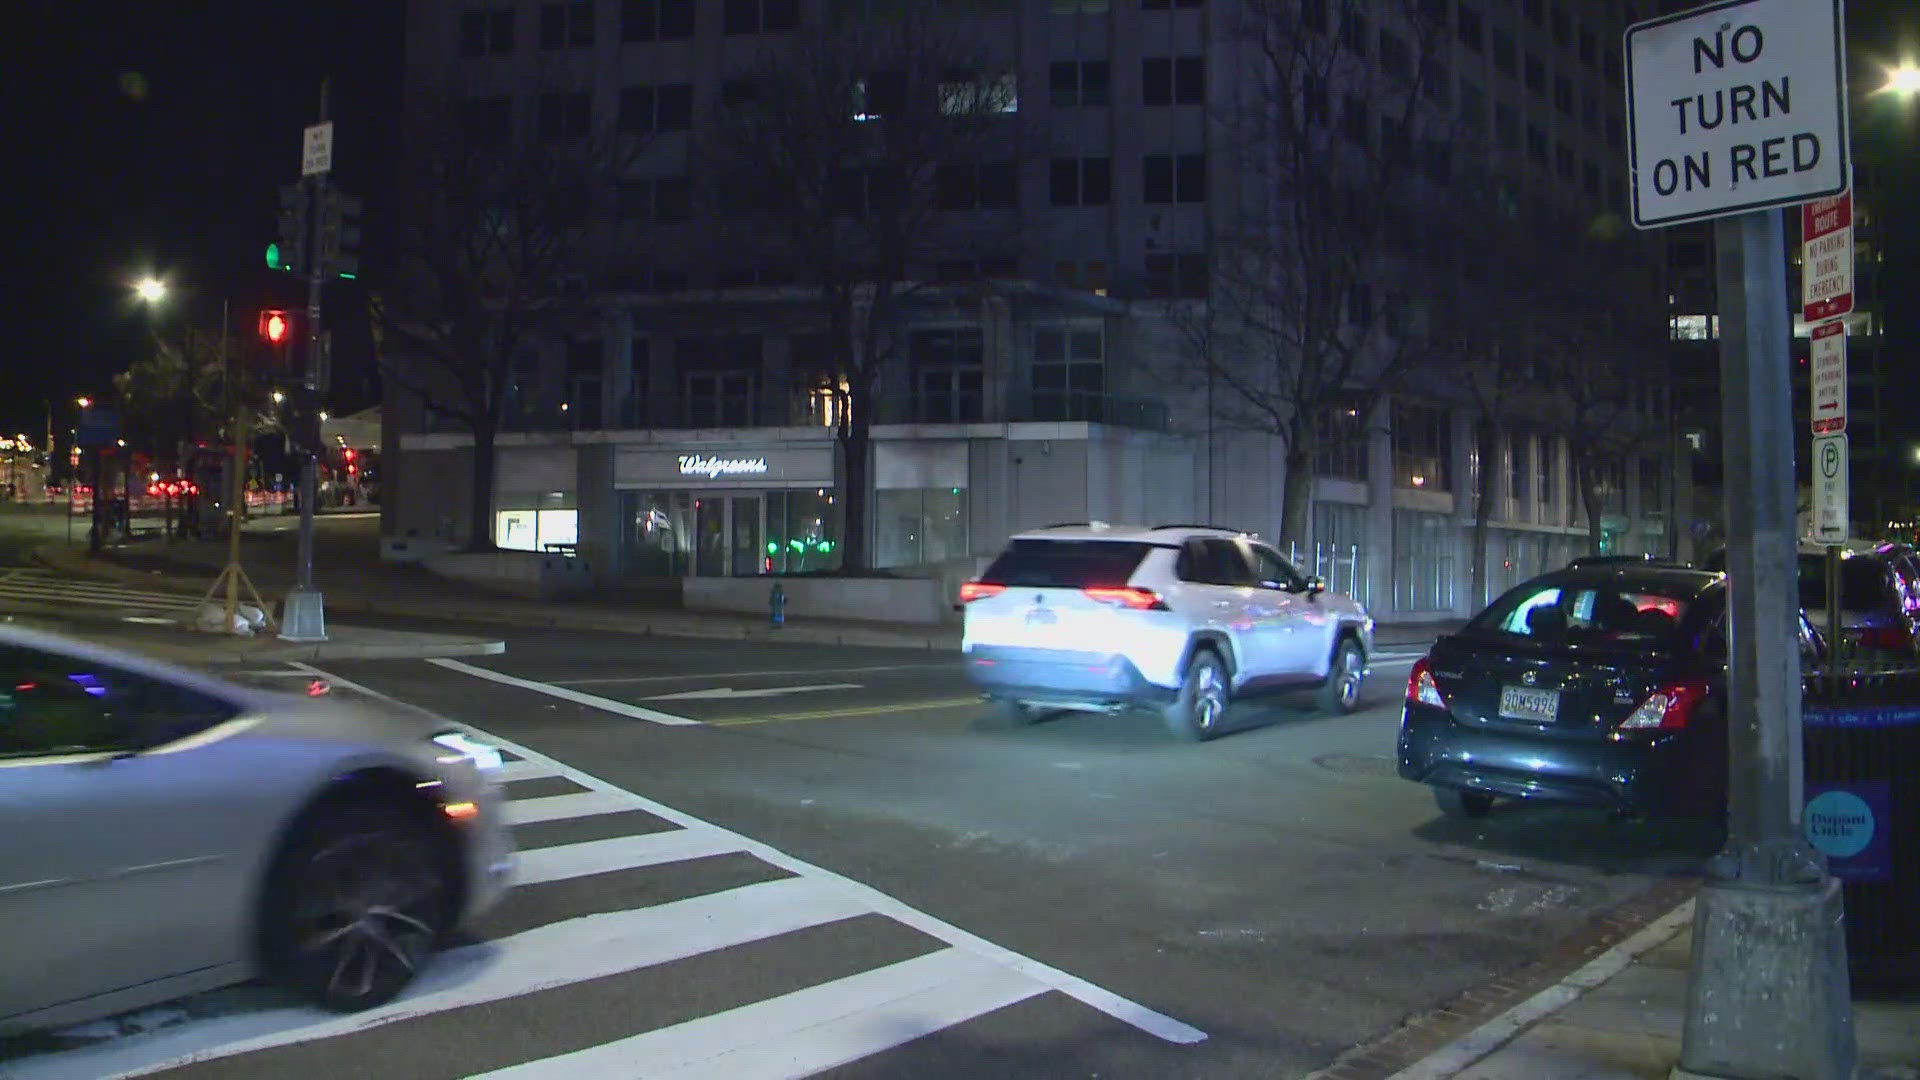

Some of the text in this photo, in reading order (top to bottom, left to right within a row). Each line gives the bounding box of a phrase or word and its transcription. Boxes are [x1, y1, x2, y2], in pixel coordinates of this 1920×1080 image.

[1693, 24, 1763, 74] NO
[1671, 76, 1790, 135] TURN
[1653, 132, 1821, 196] ON RED
[1815, 209, 1838, 234] ROUTE
[1810, 236, 1845, 259] NO PARKING
[1816, 255, 1838, 277] DURING
[1810, 275, 1844, 298] EMERGENCY
[679, 454, 767, 479] Walgreens
[1812, 813, 1865, 827] Dupont
